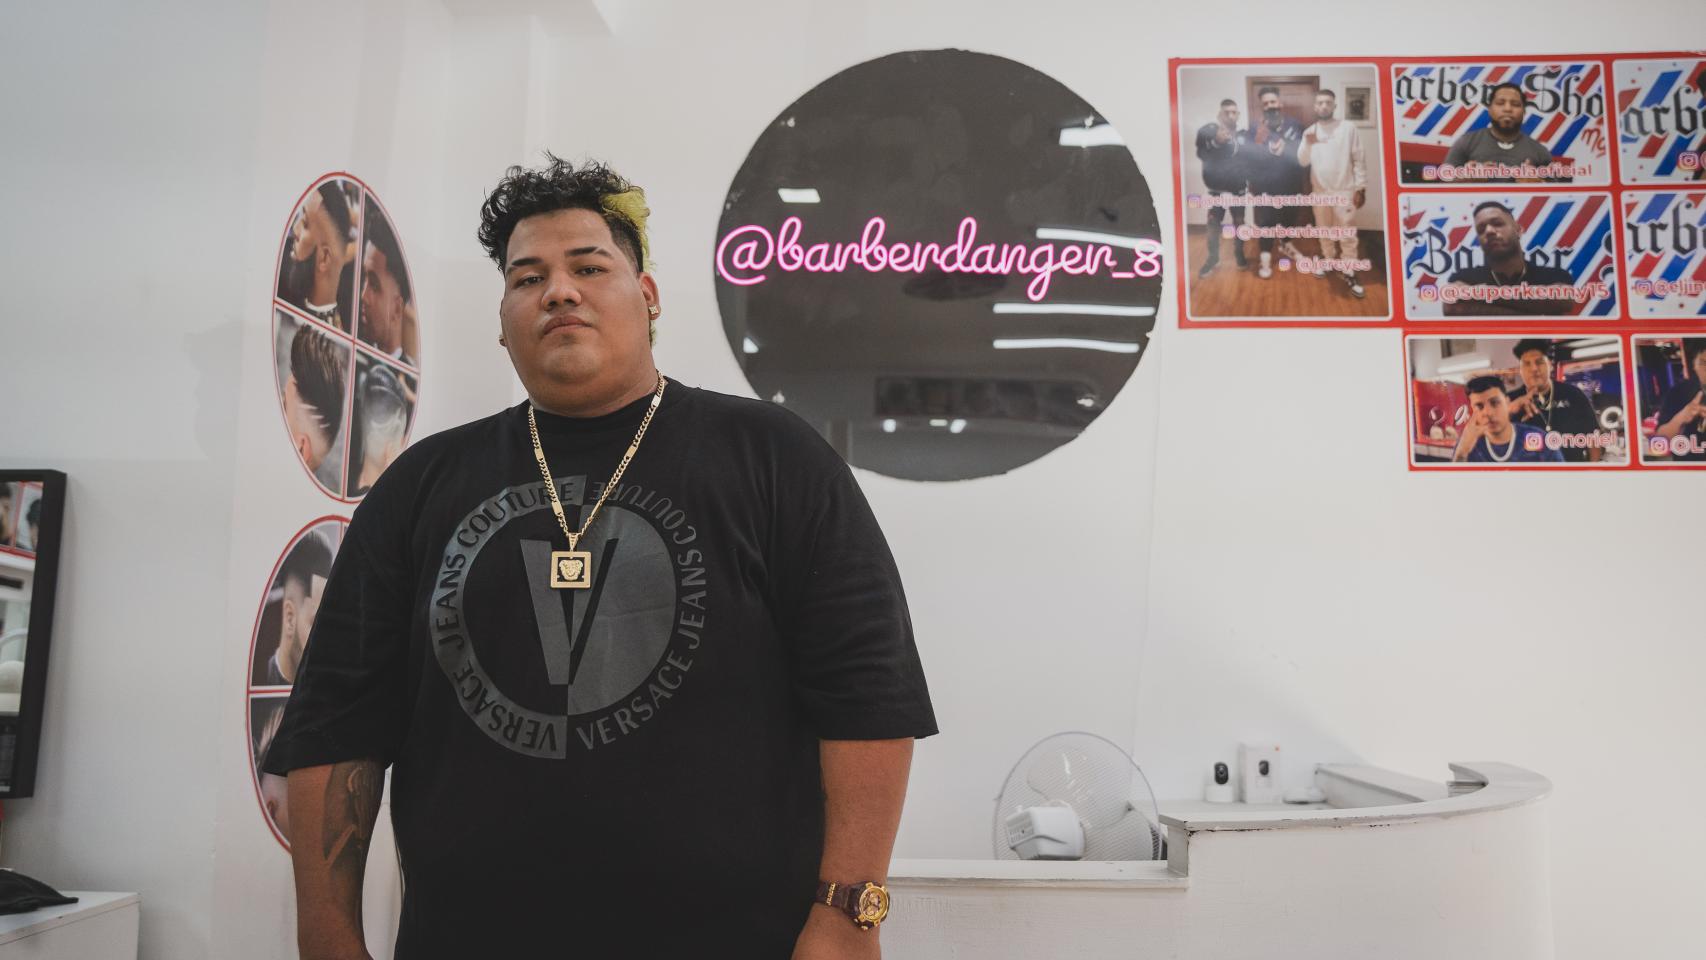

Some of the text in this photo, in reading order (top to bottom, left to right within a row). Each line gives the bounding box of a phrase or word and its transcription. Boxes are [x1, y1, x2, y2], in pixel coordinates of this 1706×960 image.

[1623, 86, 1706, 136] arb
[716, 216, 1163, 301] @barberdanger_8
[1439, 281, 1611, 304] @superkenny15
[1545, 429, 1618, 450] @noriel
[436, 552, 466, 650] JEANS
[576, 650, 694, 750] VERSACE
[677, 548, 707, 650] JEANS
[453, 656, 557, 752] VERSACE
